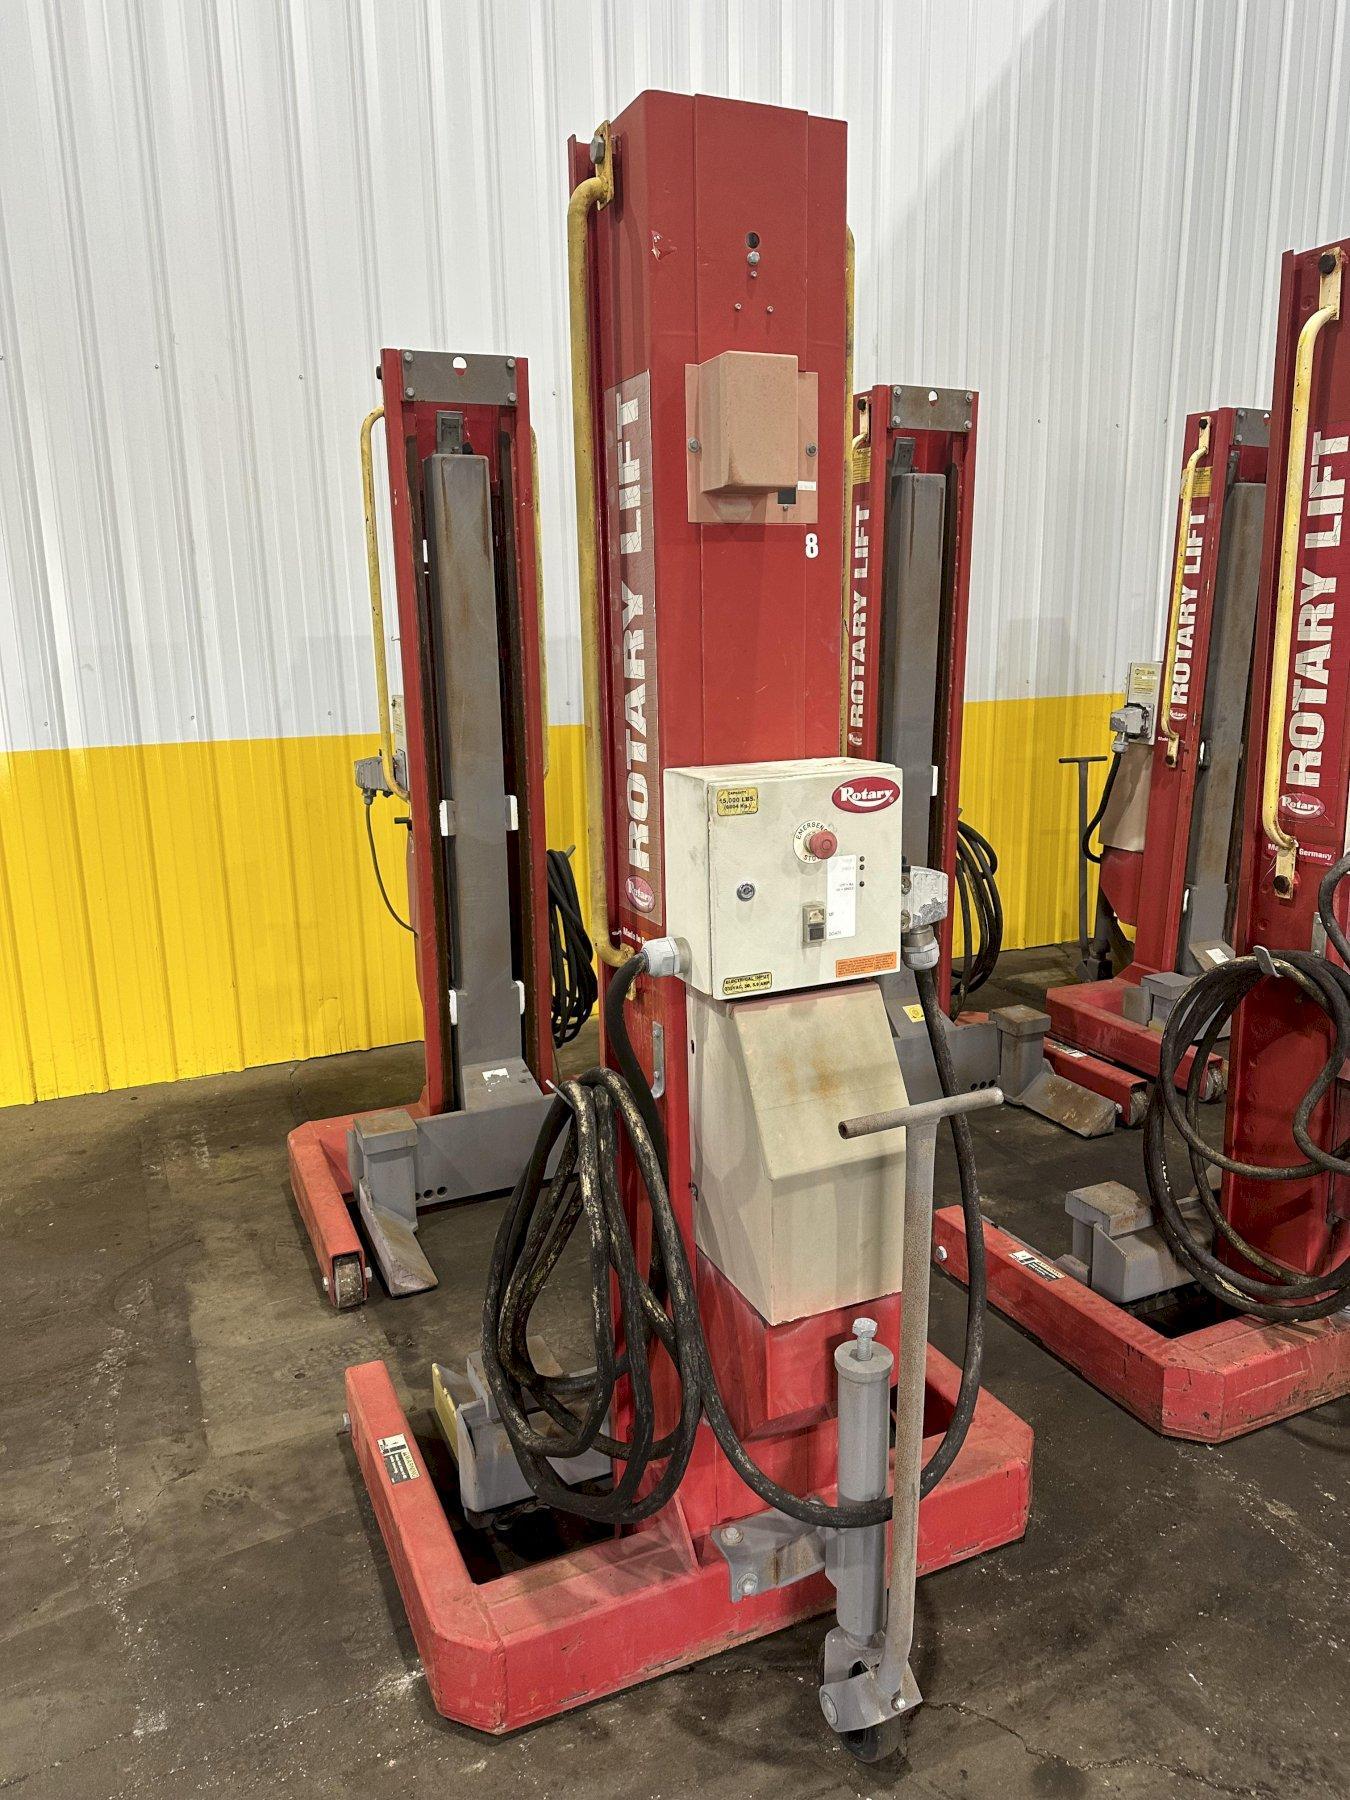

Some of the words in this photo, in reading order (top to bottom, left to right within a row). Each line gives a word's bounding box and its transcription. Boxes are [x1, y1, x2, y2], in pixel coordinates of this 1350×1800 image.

[616, 392, 643, 554] LIFT
[1305, 430, 1349, 549] LIFT
[805, 532, 819, 558] 8
[854, 504, 871, 579] LIFT
[1184, 510, 1205, 574] LIFT
[849, 590, 868, 728] ROTARY
[1170, 584, 1199, 705] ROTARY
[1286, 567, 1338, 788] ROTARY
[621, 580, 650, 871] ROTARY
[796, 821, 828, 840] EMERGEN
[840, 786, 894, 807] Rotary
[1281, 795, 1321, 815] Rotary
[804, 854, 819, 862] STO
[1267, 843, 1279, 852] Ma
[1298, 848, 1332, 861] Germany
